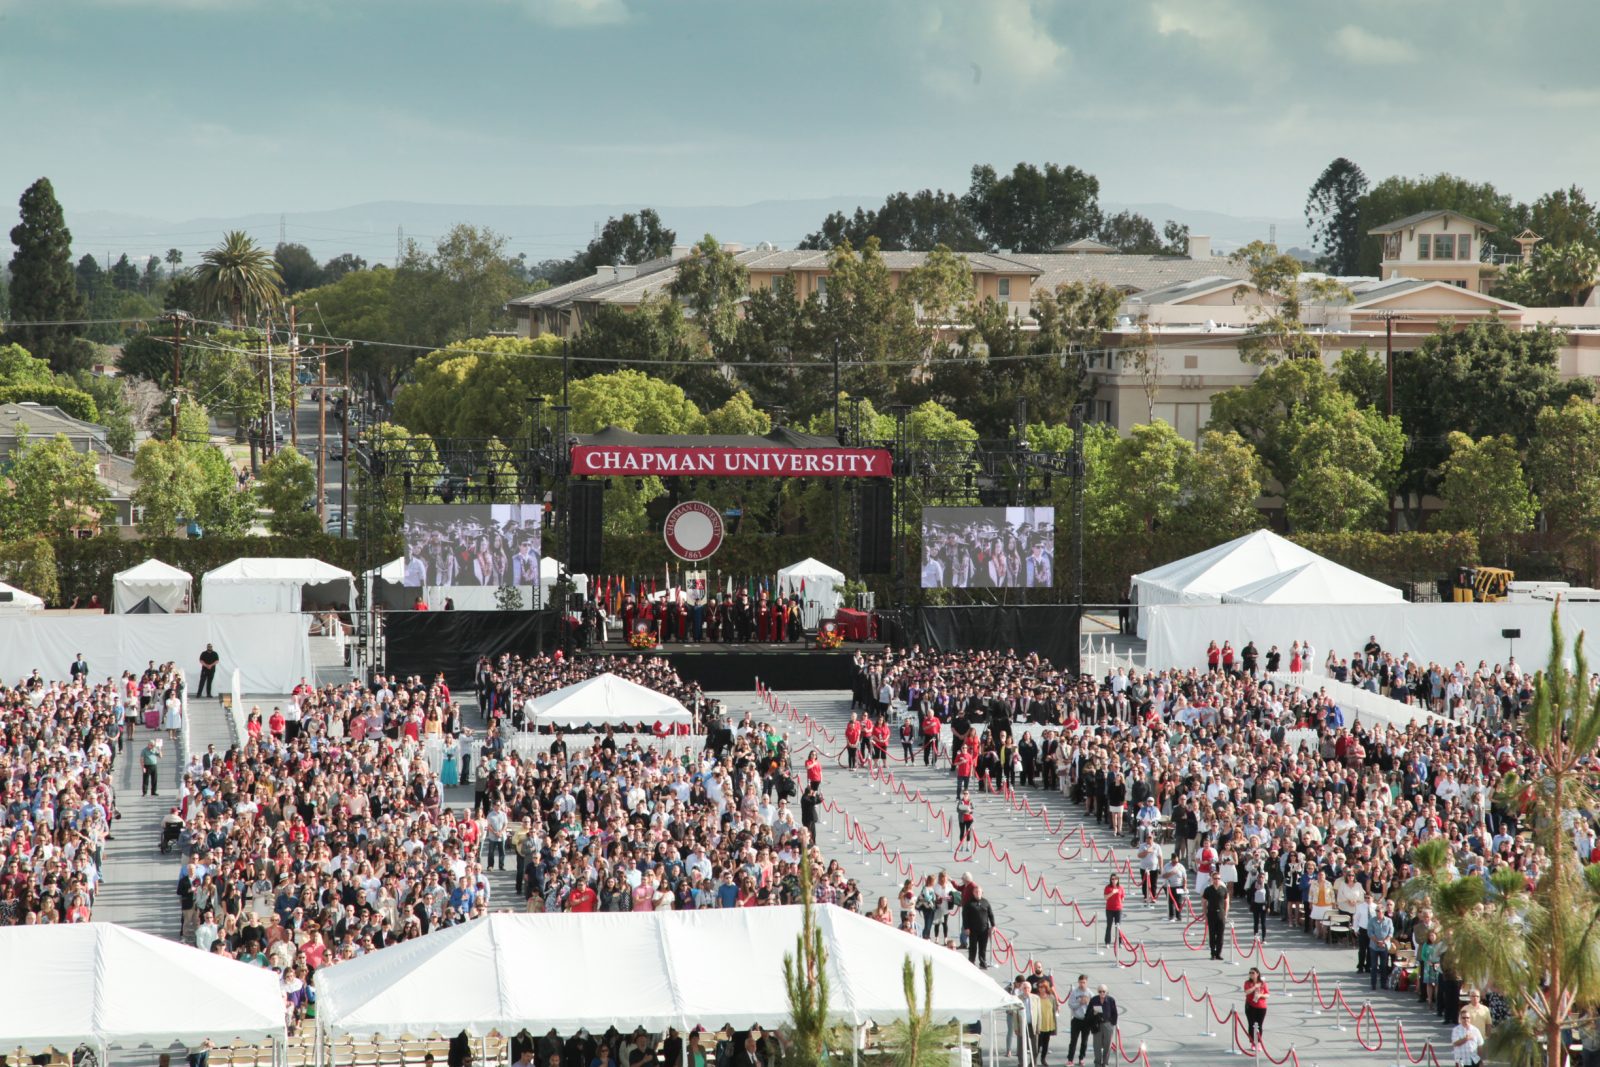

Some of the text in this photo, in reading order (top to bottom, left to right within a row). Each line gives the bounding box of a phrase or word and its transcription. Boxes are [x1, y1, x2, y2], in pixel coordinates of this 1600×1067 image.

[586, 452, 876, 472] CHAPMAN UNIVERSITY
[667, 504, 720, 537] CHAPMAN UNIVERSITY
